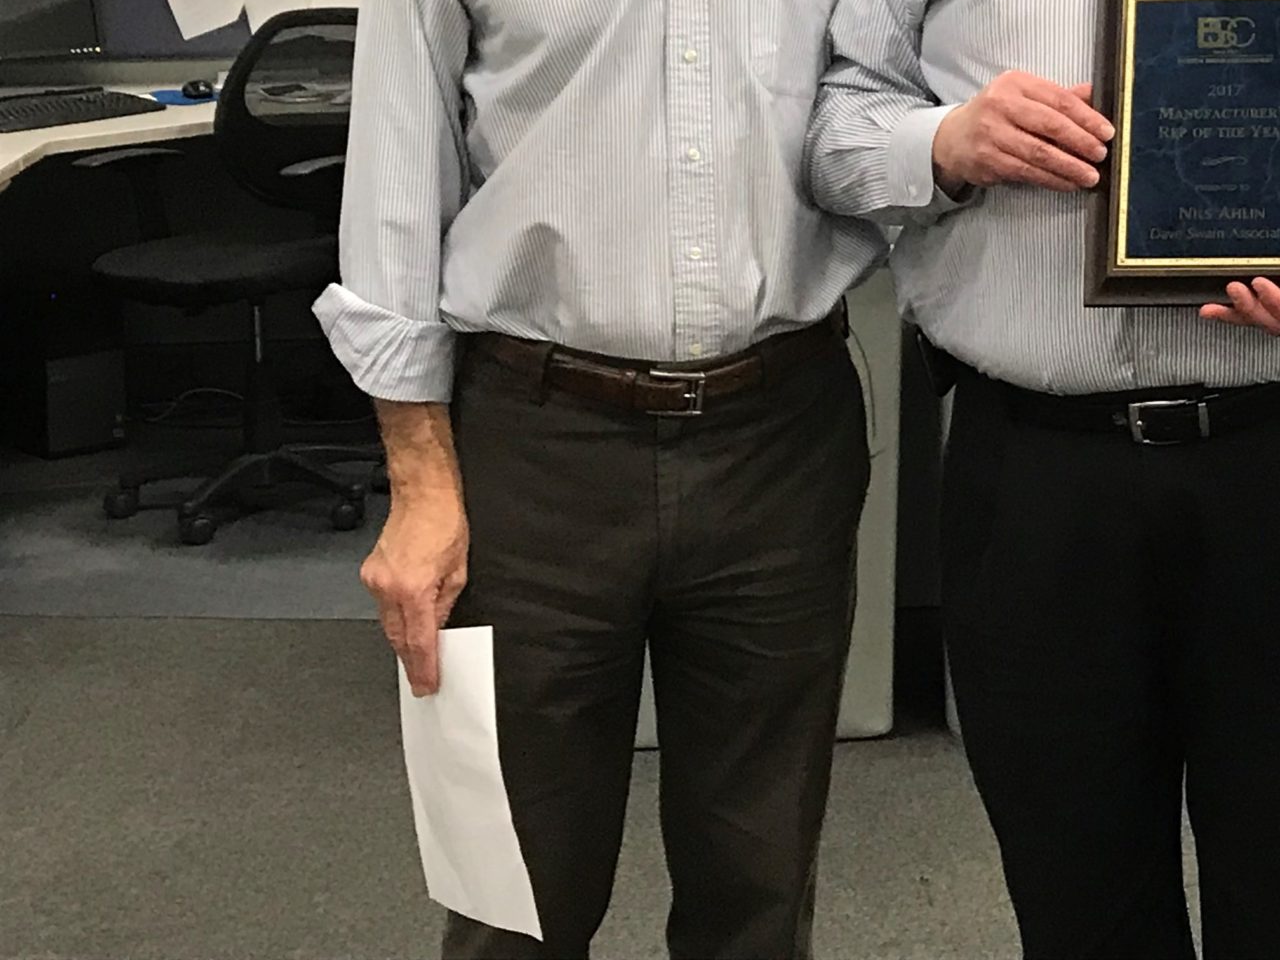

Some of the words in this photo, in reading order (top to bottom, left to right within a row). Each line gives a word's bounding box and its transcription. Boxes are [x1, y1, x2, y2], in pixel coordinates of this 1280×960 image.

[1208, 85, 1243, 97] 2017
[1159, 126, 1188, 138] REP
[1193, 126, 1211, 138] OF
[1216, 126, 1245, 138] THE
[1178, 207, 1213, 220] NILS
[1218, 206, 1266, 220] AHLIN
[1150, 228, 1183, 240] Dave
[1186, 227, 1226, 240] Swain
